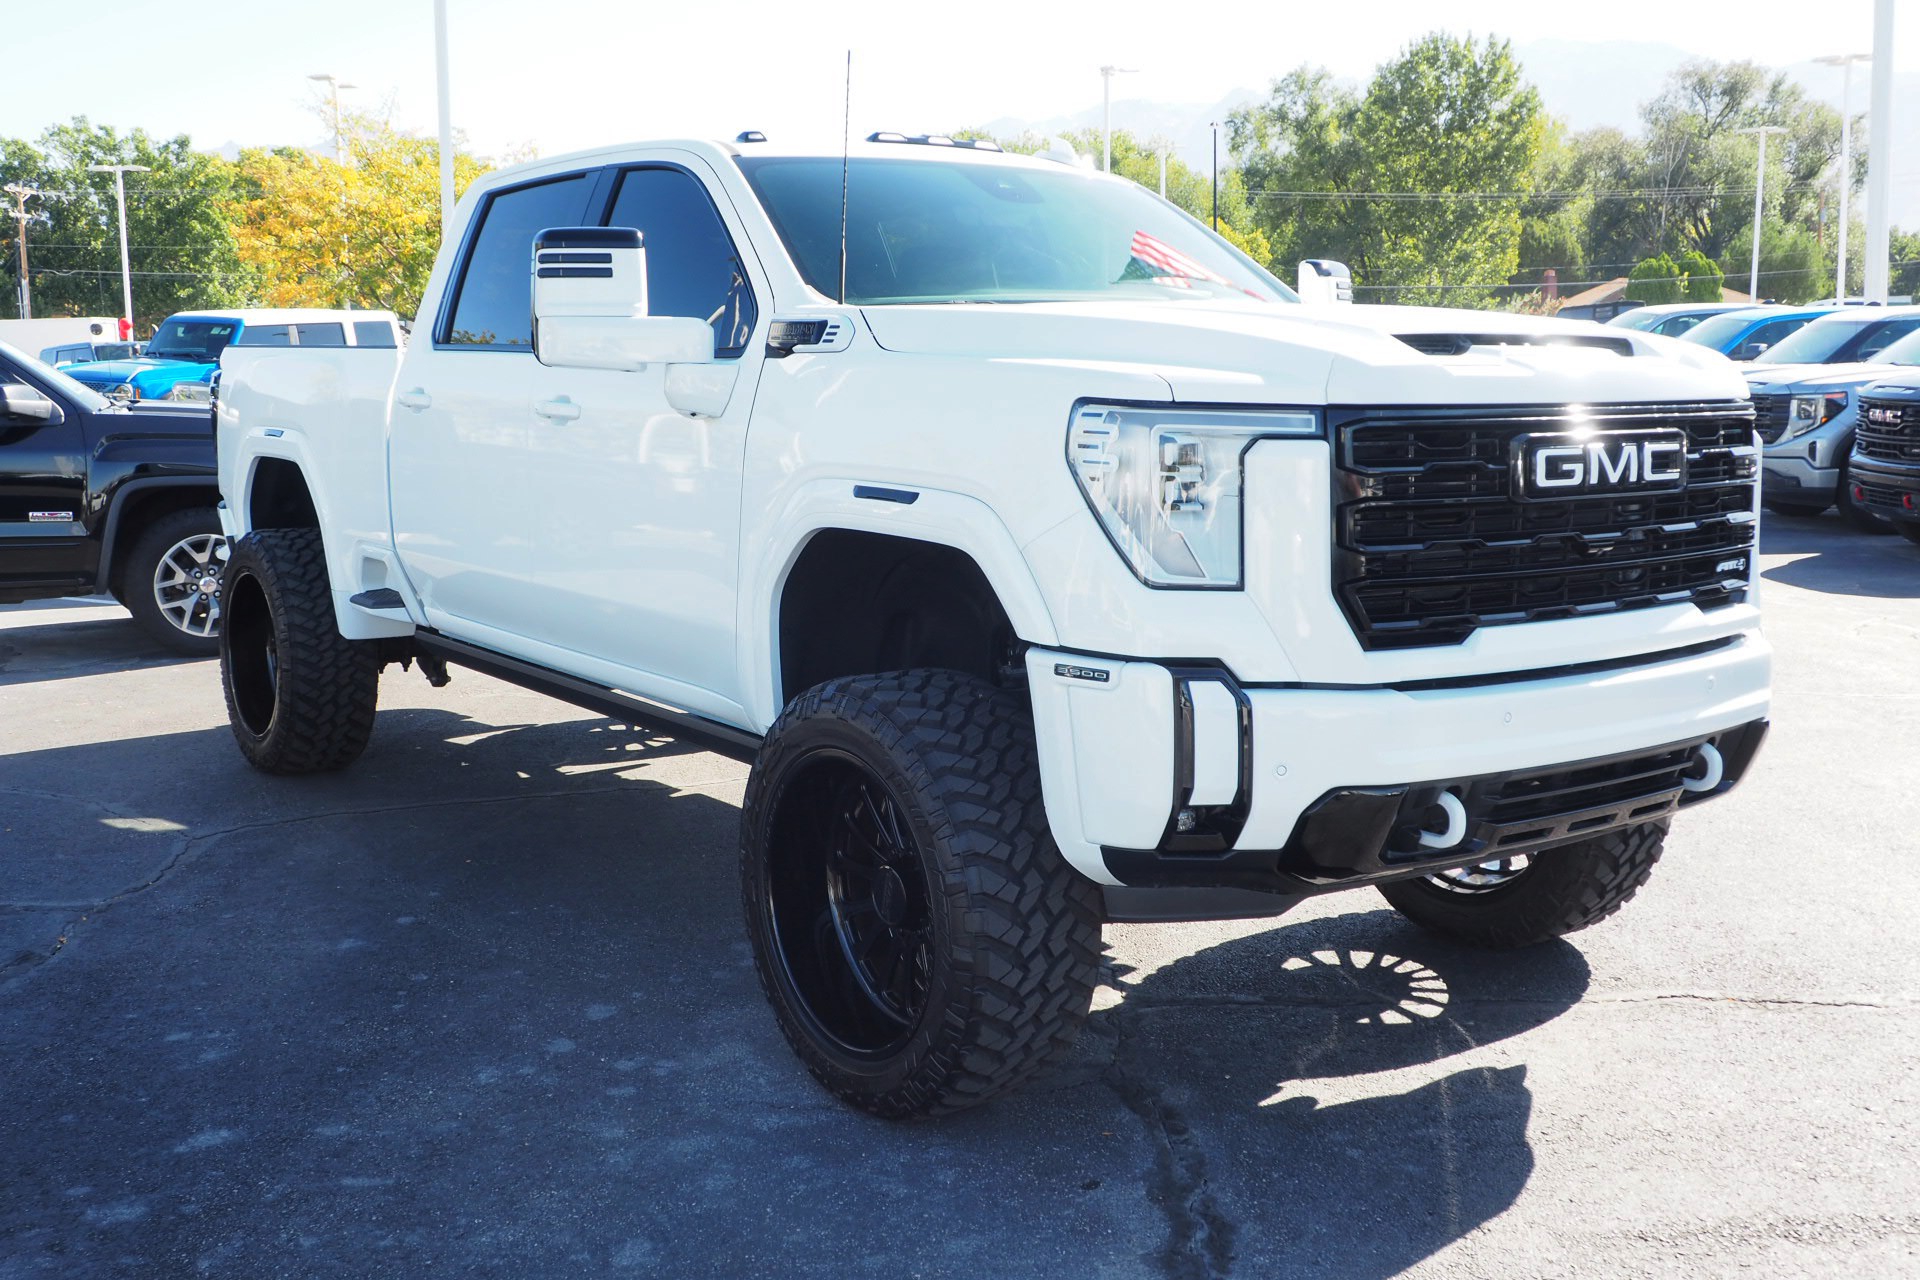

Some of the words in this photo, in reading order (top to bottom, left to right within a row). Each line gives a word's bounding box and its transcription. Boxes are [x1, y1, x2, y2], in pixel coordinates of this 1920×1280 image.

[1868, 408, 1901, 423] GMC
[1536, 442, 1680, 487] GMC
[1716, 557, 1746, 572] AT4
